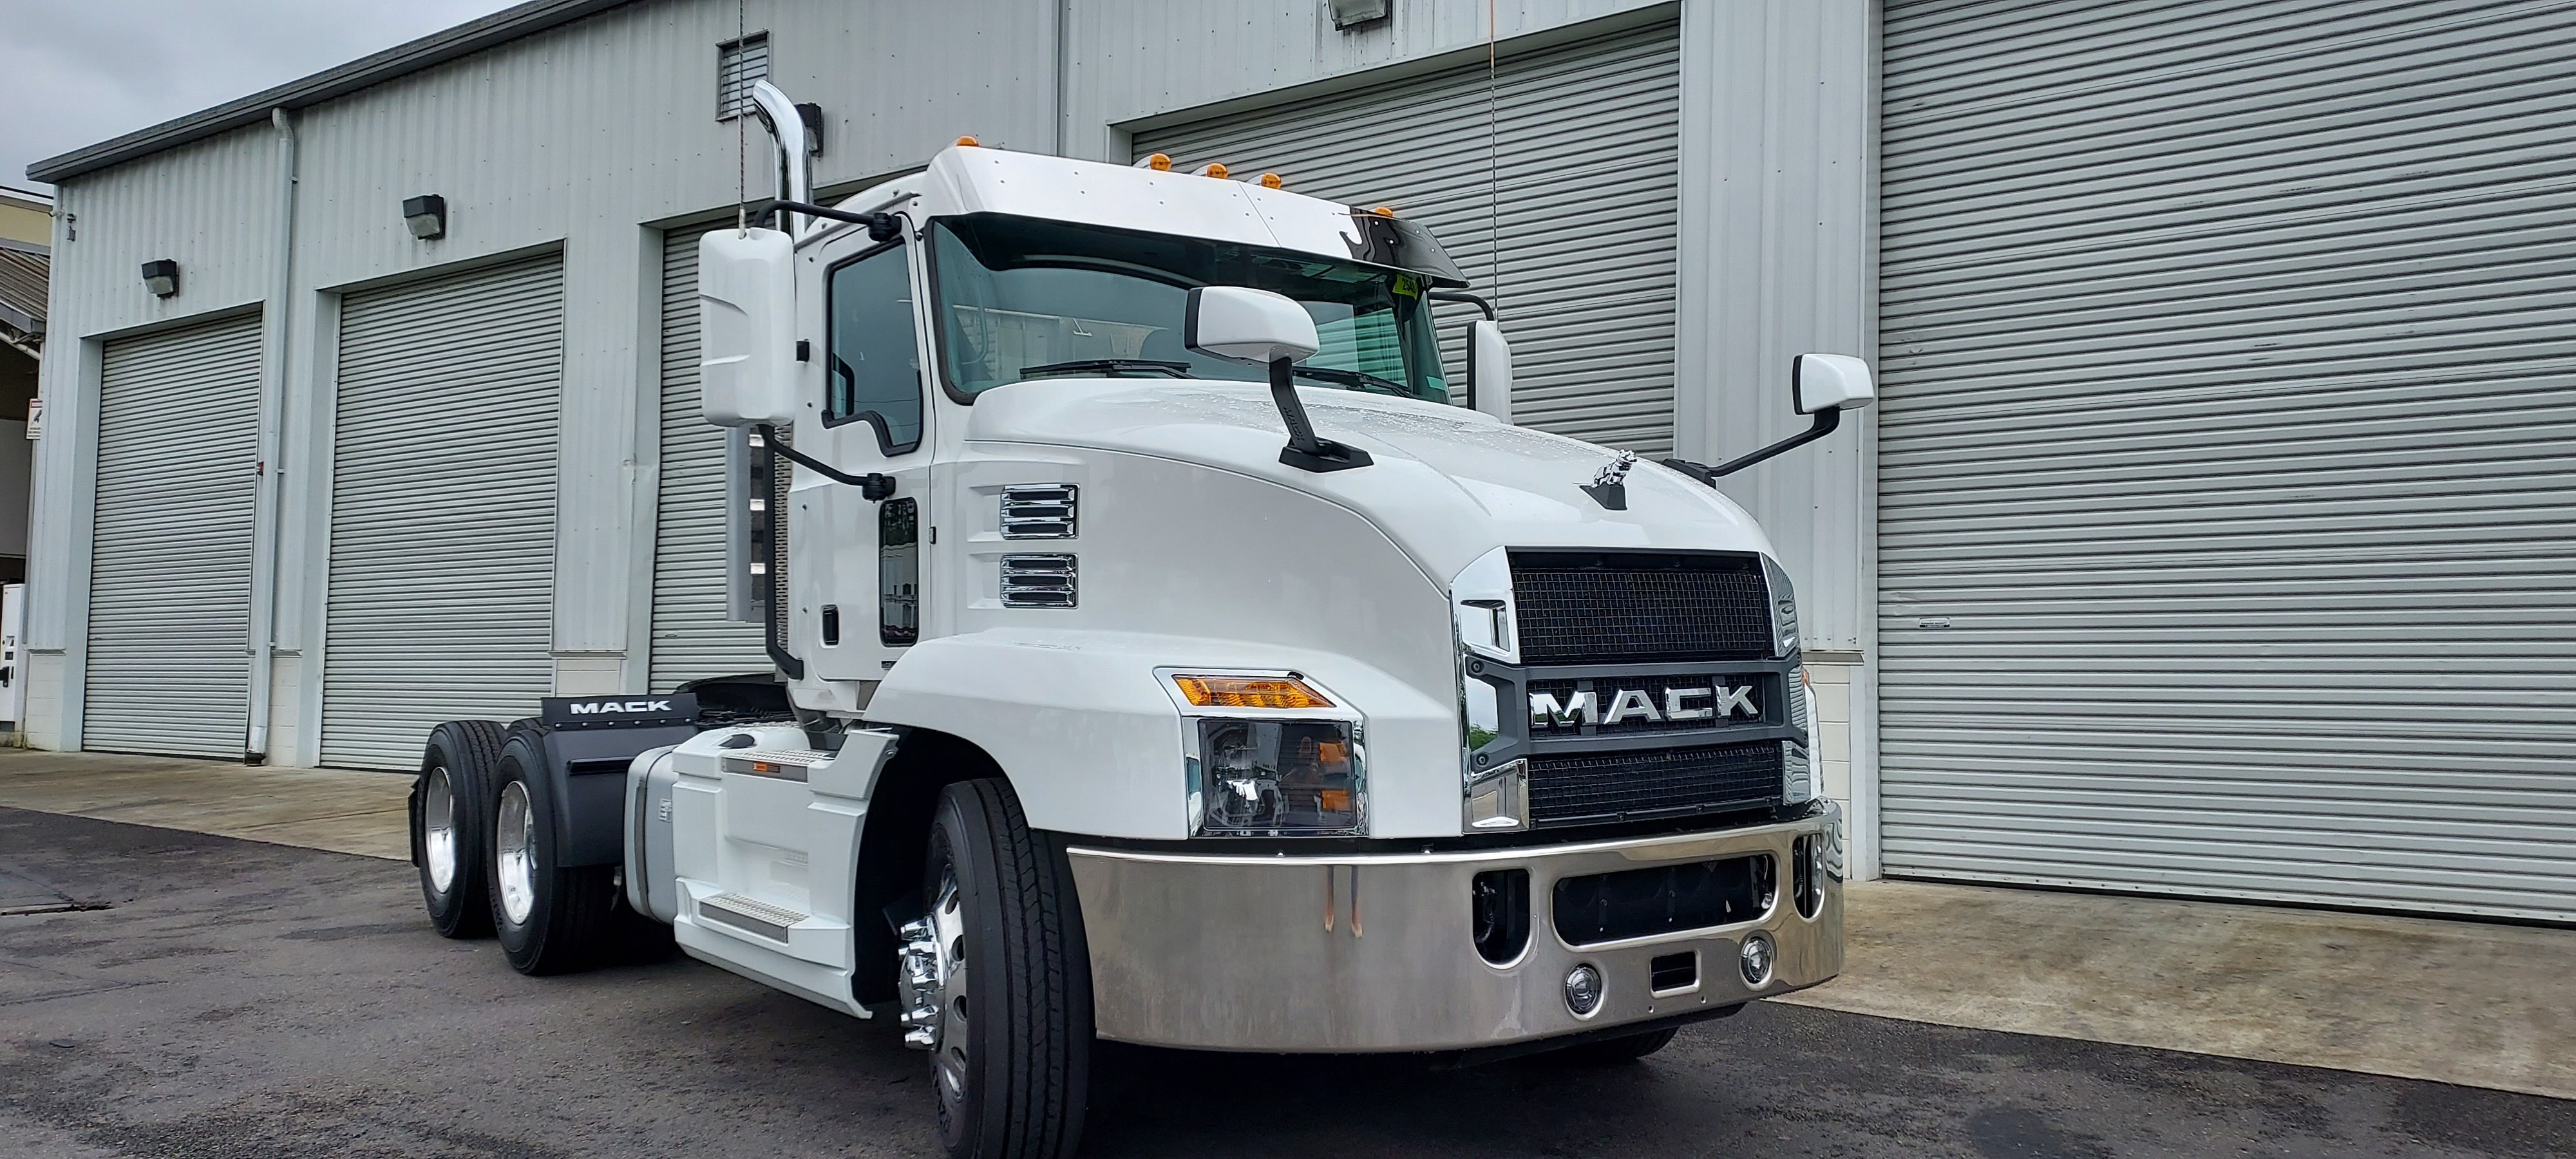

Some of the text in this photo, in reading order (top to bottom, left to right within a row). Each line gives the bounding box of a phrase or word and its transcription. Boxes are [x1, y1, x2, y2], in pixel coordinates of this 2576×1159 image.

[1283, 407, 1305, 441] MACK
[570, 700, 672, 714] MACK
[1529, 685, 1759, 728] MACK
